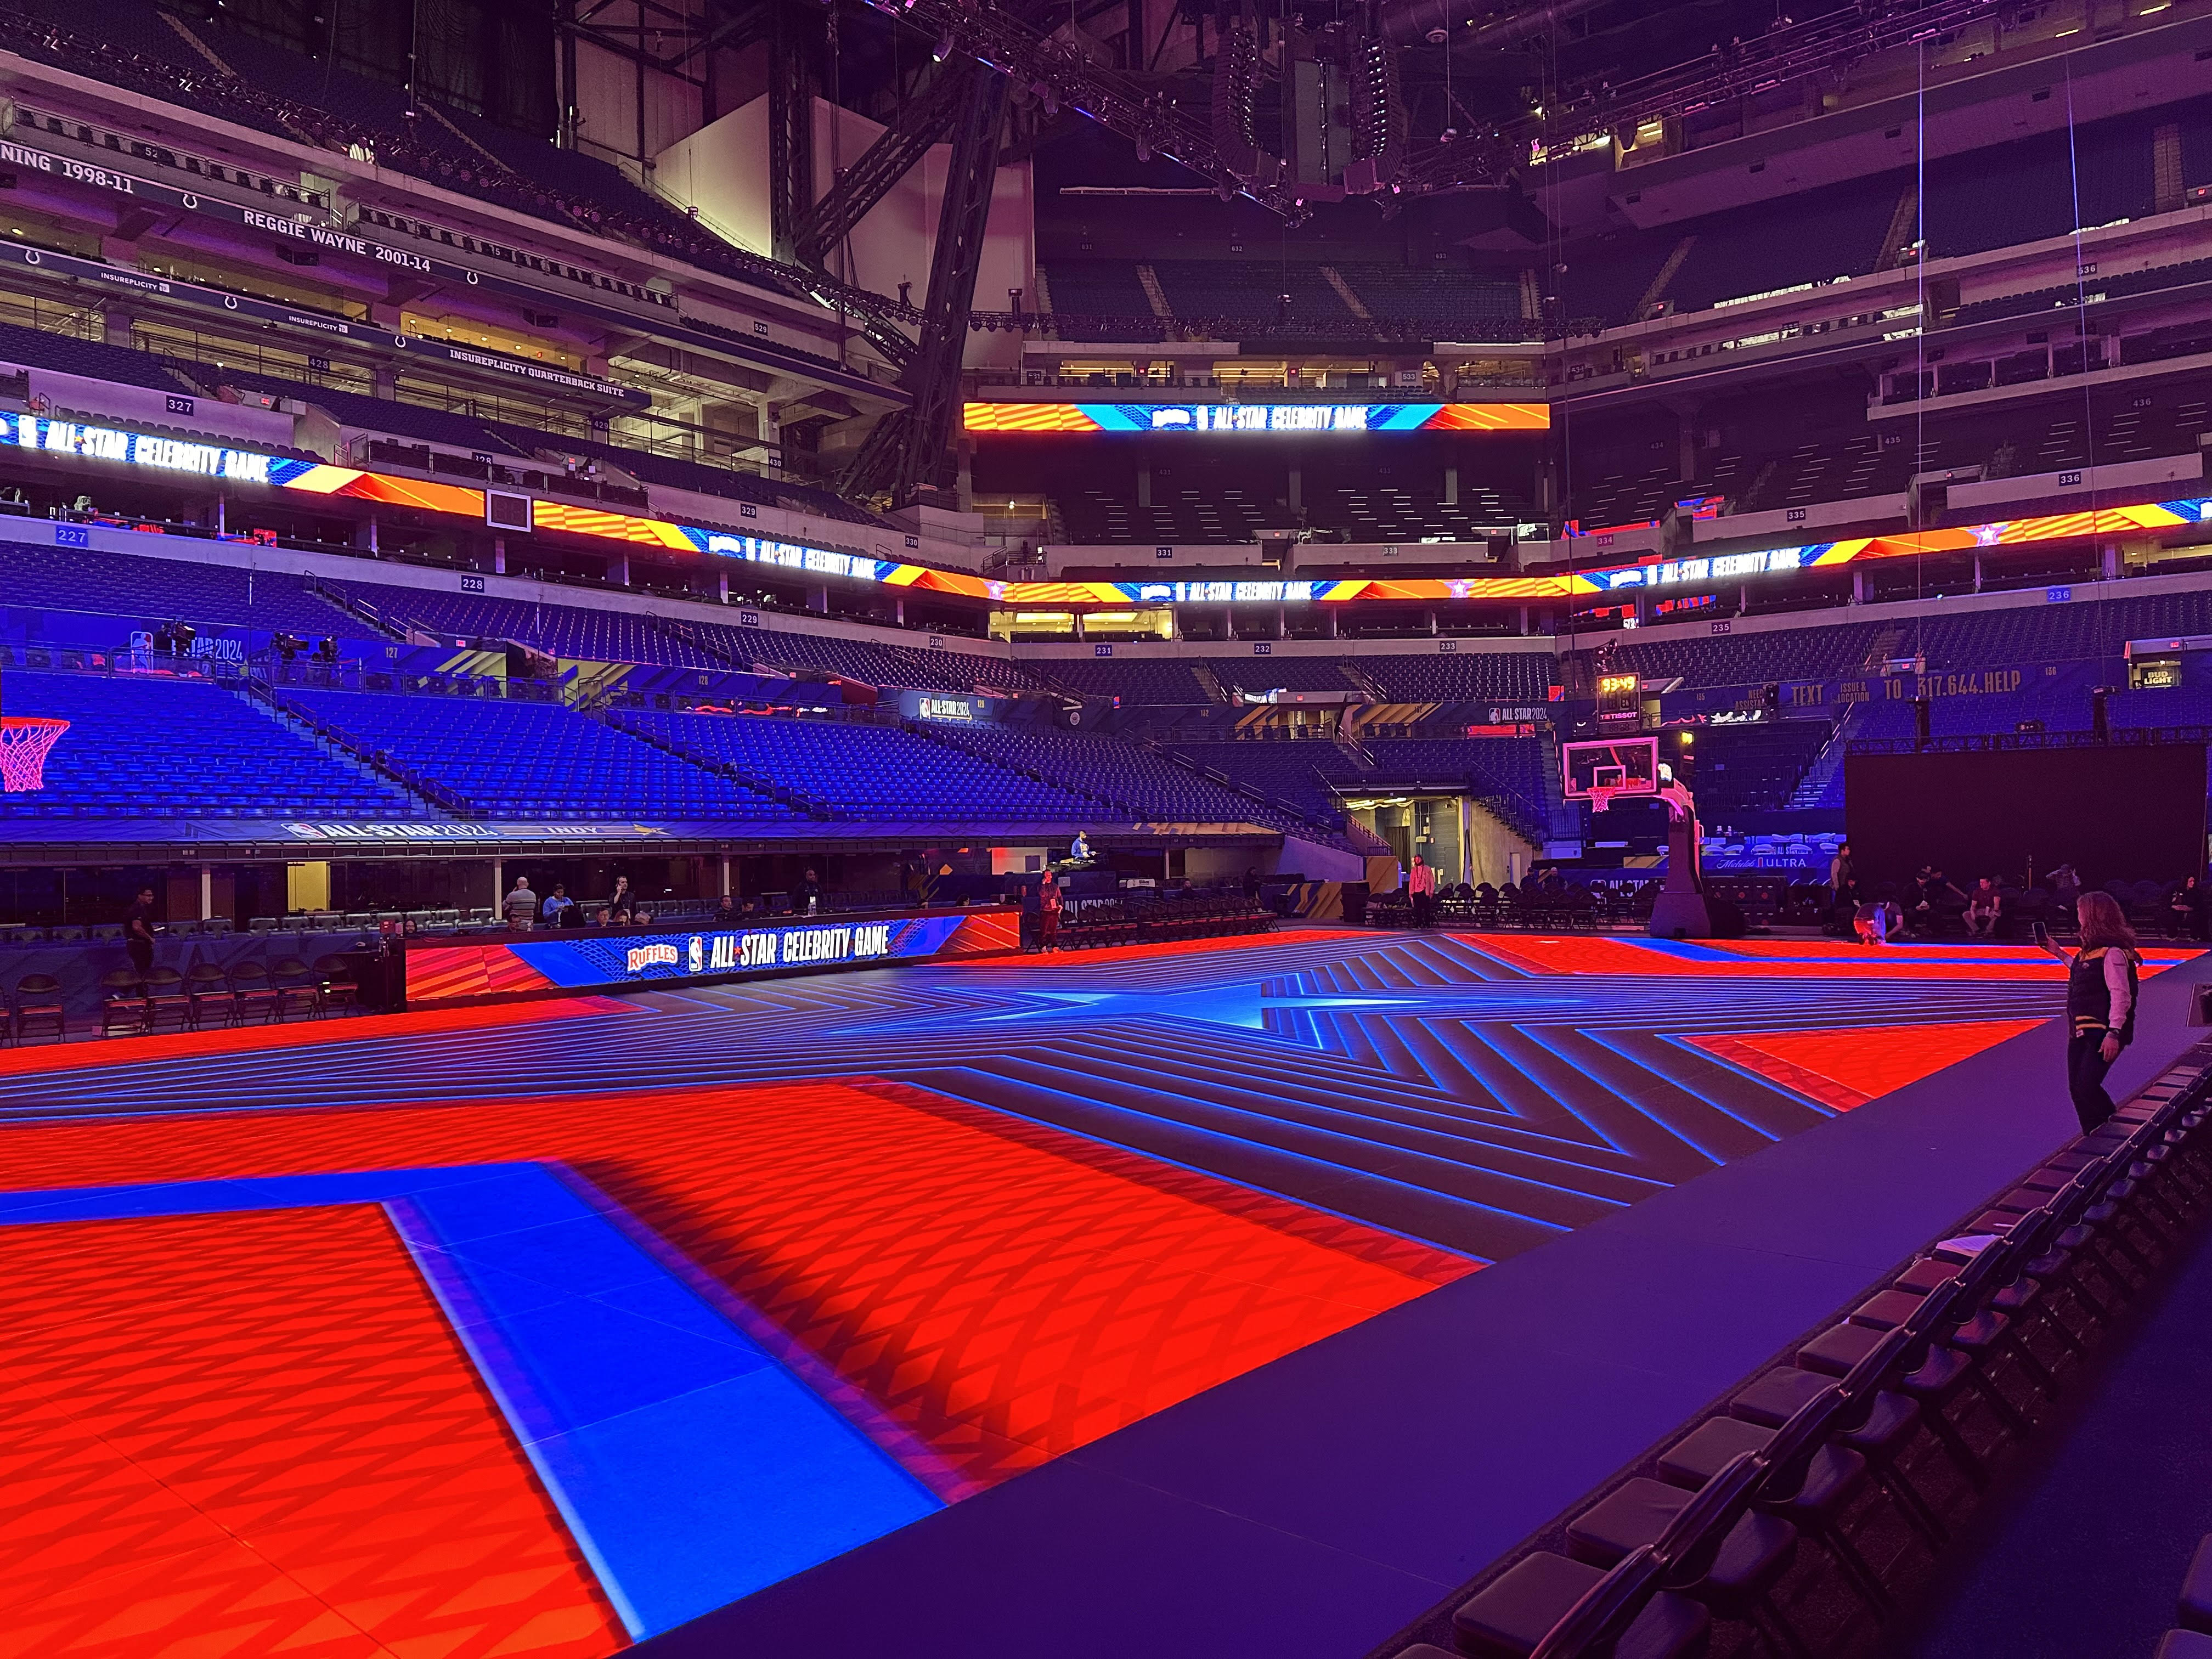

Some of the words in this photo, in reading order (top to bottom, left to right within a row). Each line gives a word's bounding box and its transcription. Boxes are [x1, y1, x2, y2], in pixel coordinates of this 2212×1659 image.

[1, 144, 50, 171] NING
[63, 161, 133, 194] 1998-11
[244, 210, 305, 238] REGGIE
[311, 228, 366, 255] WAYNE
[375, 247, 431, 272] 2001-14
[101, 272, 157, 290] INSUREPLICITY
[289, 315, 337, 331] INSUREPLICITY
[755, 324, 767, 332] 529
[310, 358, 328, 369] 428
[450, 349, 527, 375] INSUREPLICITY
[528, 368, 596, 391] QUARTERBACK
[597, 384, 624, 397] SUITE
[168, 399, 191, 412] 327
[2133, 398, 2151, 407] 436
[594, 421, 608, 430] 429
[1885, 436, 1900, 444] 435
[134, 436, 221, 475] CELEBRITY
[769, 459, 781, 467] 430
[2061, 474, 2080, 483] 336
[741, 506, 755, 516] 329
[1788, 511, 1804, 519] 335
[58, 529, 86, 543] 227
[906, 538, 918, 546] 330
[462, 578, 483, 590] 228
[2049, 590, 2069, 600] 236
[742, 614, 758, 624] 229
[1713, 623, 1729, 632] 235
[930, 638, 943, 647] 230
[215, 639, 242, 661] 2024
[386, 647, 398, 659] 127
[698, 675, 708, 685] 128
[1602, 676, 1635, 692] 93:49
[2144, 676, 2172, 685] LIGHT
[1841, 682, 1860, 692] ISSUE
[1884, 679, 1901, 700] TO
[1791, 685, 1824, 706] TEXT
[1838, 692, 1870, 704] LOCATION
[1532, 708, 1547, 720] 2024
[1611, 712, 1637, 720] TISSOT
[1716, 859, 1756, 869] Michelob
[1766, 858, 1806, 867] ULTRA
[783, 928, 850, 962] CELEBRITY
[854, 926, 889, 956] GAME
[629, 946, 676, 969] RUFFLES
